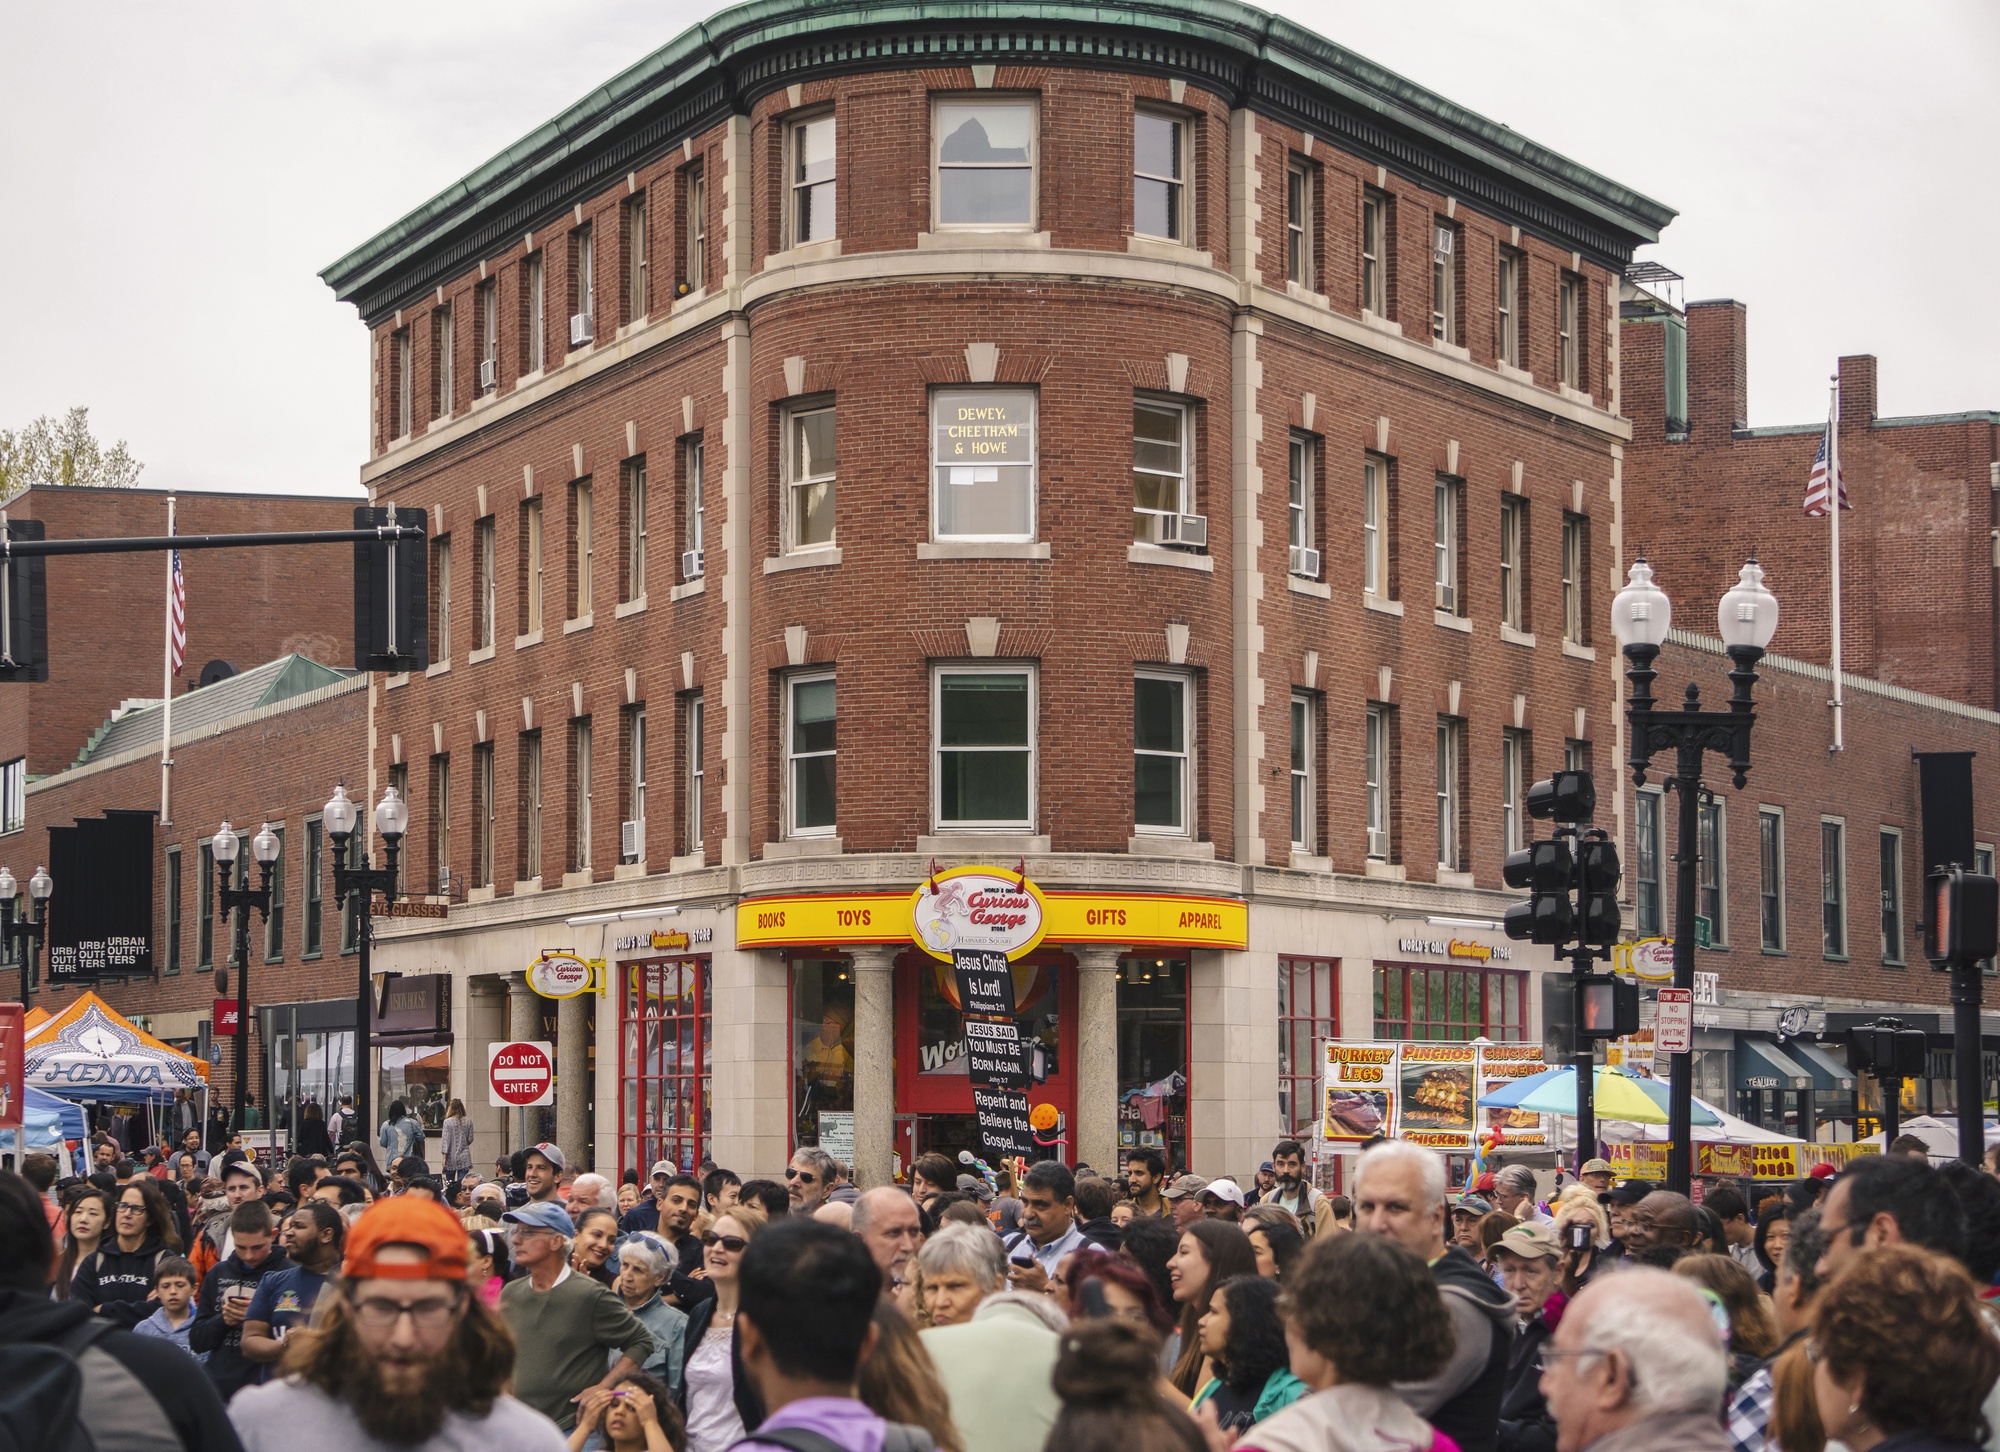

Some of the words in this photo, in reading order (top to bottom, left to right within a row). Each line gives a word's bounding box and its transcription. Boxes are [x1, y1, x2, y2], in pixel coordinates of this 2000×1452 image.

[958, 408, 1006, 420] DEWEY,
[948, 425, 1018, 438] CHEETHAM
[955, 442, 963, 455] &
[972, 442, 1008, 454] HOWE
[967, 890, 1029, 909] Curious
[370, 904, 389, 916] EYE
[392, 904, 441, 918] GLASSES
[837, 909, 871, 926] TOYS
[1086, 909, 1127, 926] GIFTS
[758, 911, 786, 929] BOOKS
[970, 908, 1027, 930] George
[1178, 912, 1222, 930] APPAREL
[107, 937, 145, 946] URBAN
[613, 936, 637, 951] WORLD'S
[1399, 939, 1428, 953] WORLD'S
[107, 946, 150, 955] OUTFIT-
[79, 959, 105, 968] TERS
[107, 956, 136, 964] TERS
[955, 953, 980, 970] Jesus
[982, 953, 1007, 973] Christ
[555, 964, 583, 973] Curious
[556, 972, 582, 982] George
[968, 978, 977, 995] Is
[979, 978, 1001, 997] Lord!
[1660, 993, 1671, 1001] TOW
[1674, 993, 1689, 1001] ZONE
[970, 1001, 995, 1011] Philippians
[996, 1003, 1006, 1011] 2:11
[1661, 1017, 1686, 1025] STOPPING
[969, 1025, 993, 1036] JESUS
[996, 1027, 1015, 1038] SAID
[1661, 1029, 1685, 1037] ANYTIME
[968, 1038, 985, 1052] YOU
[986, 1041, 1006, 1054] MUST
[1009, 1042, 1021, 1056] BE
[1401, 1045, 1475, 1061] PINCHOS
[499, 1055, 514, 1066] DO
[520, 1054, 542, 1065] NOT
[1328, 1046, 1394, 1063] TURKEY
[972, 1057, 994, 1072] BORN
[995, 1060, 1022, 1074] AGAIN.
[1482, 1064, 1548, 1077] FINGERS
[45, 1063, 163, 1085] HENNA
[1339, 1064, 1383, 1082] LEGS
[503, 1083, 538, 1093] ENTER
[1747, 1078, 1778, 1088] TEALUXE
[974, 1091, 1008, 1110] Repent
[1010, 1097, 1027, 1111] and
[979, 1111, 1012, 1129] Believe
[1014, 1116, 1028, 1132] the
[982, 1132, 1017, 1152] Gospel.
[1401, 1132, 1469, 1148] CHICKEN
[1752, 1146, 1789, 1160] Fried
